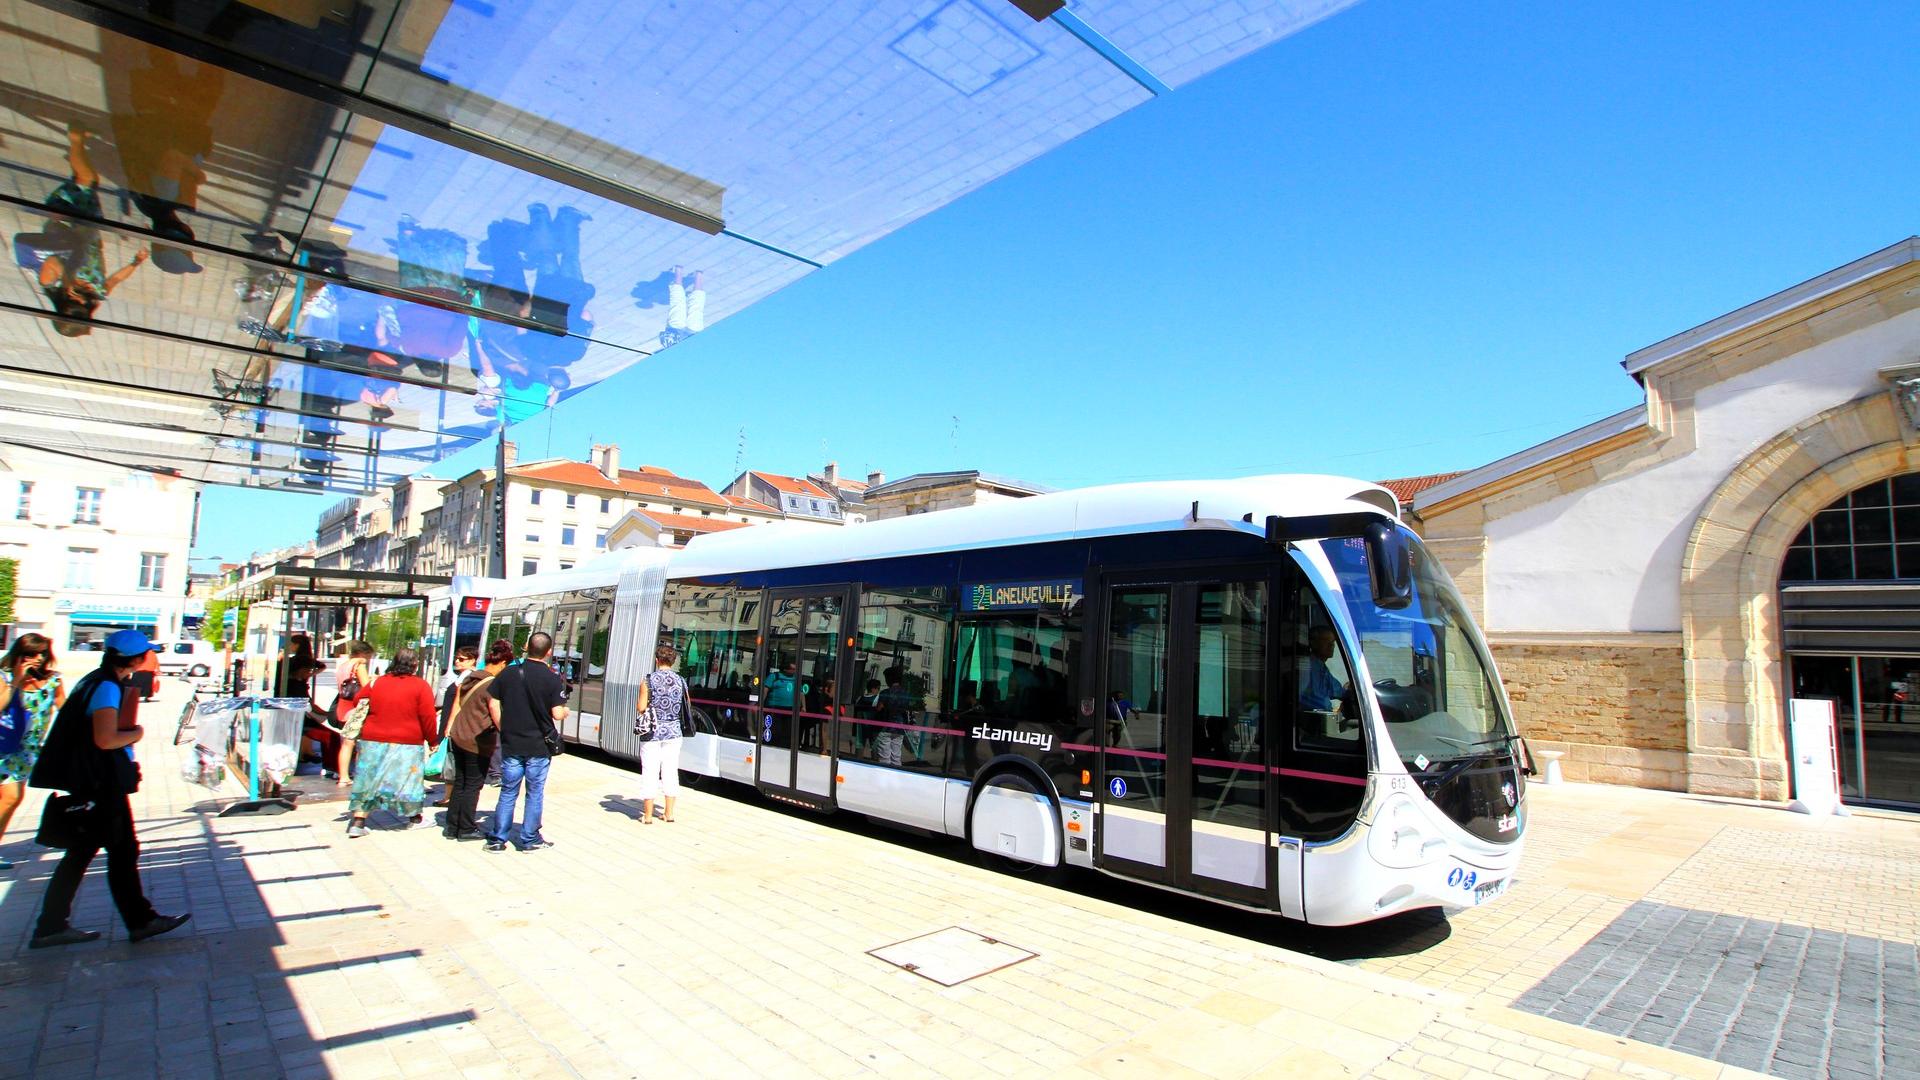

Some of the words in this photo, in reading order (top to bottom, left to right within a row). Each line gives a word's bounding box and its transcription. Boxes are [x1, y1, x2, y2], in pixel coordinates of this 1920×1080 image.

[990, 584, 1073, 605] LANEUVEVILLE
[475, 599, 483, 610] 5
[972, 722, 1053, 752] stanway
[1391, 777, 1407, 790] 613
